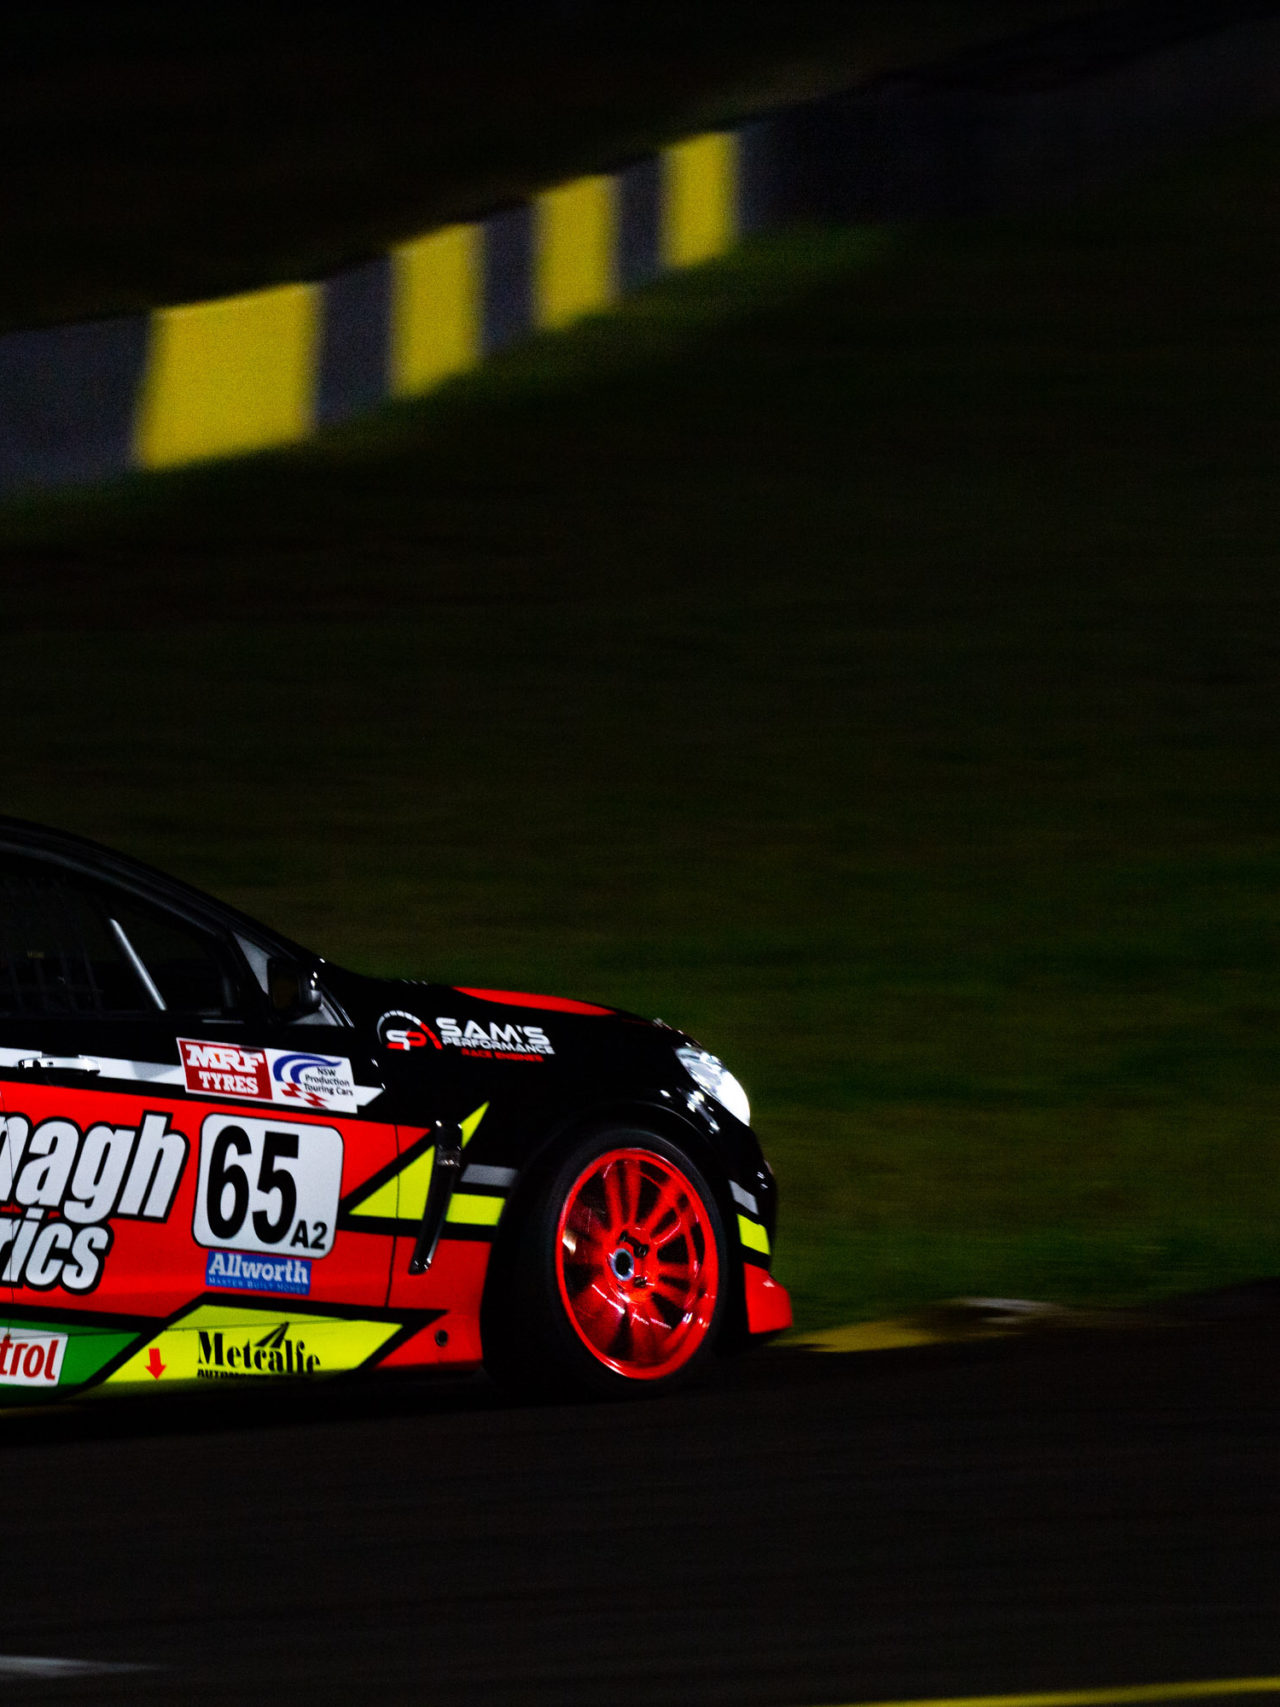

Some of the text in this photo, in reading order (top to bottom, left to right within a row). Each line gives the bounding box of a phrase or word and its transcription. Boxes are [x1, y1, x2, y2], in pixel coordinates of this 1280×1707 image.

[435, 1016, 551, 1045] SAM'S
[185, 1044, 264, 1074] MRF
[442, 1036, 556, 1055] PERFORMANCE
[199, 1071, 259, 1095] TYRES
[305, 1074, 350, 1087] Production
[317, 1067, 337, 1077] NSW
[303, 1083, 354, 1096] Touring Cars
[206, 1125, 299, 1244] 65
[290, 1220, 327, 1250] A2
[208, 1253, 309, 1284] Allworth
[198, 1330, 321, 1375] Metcalfe
